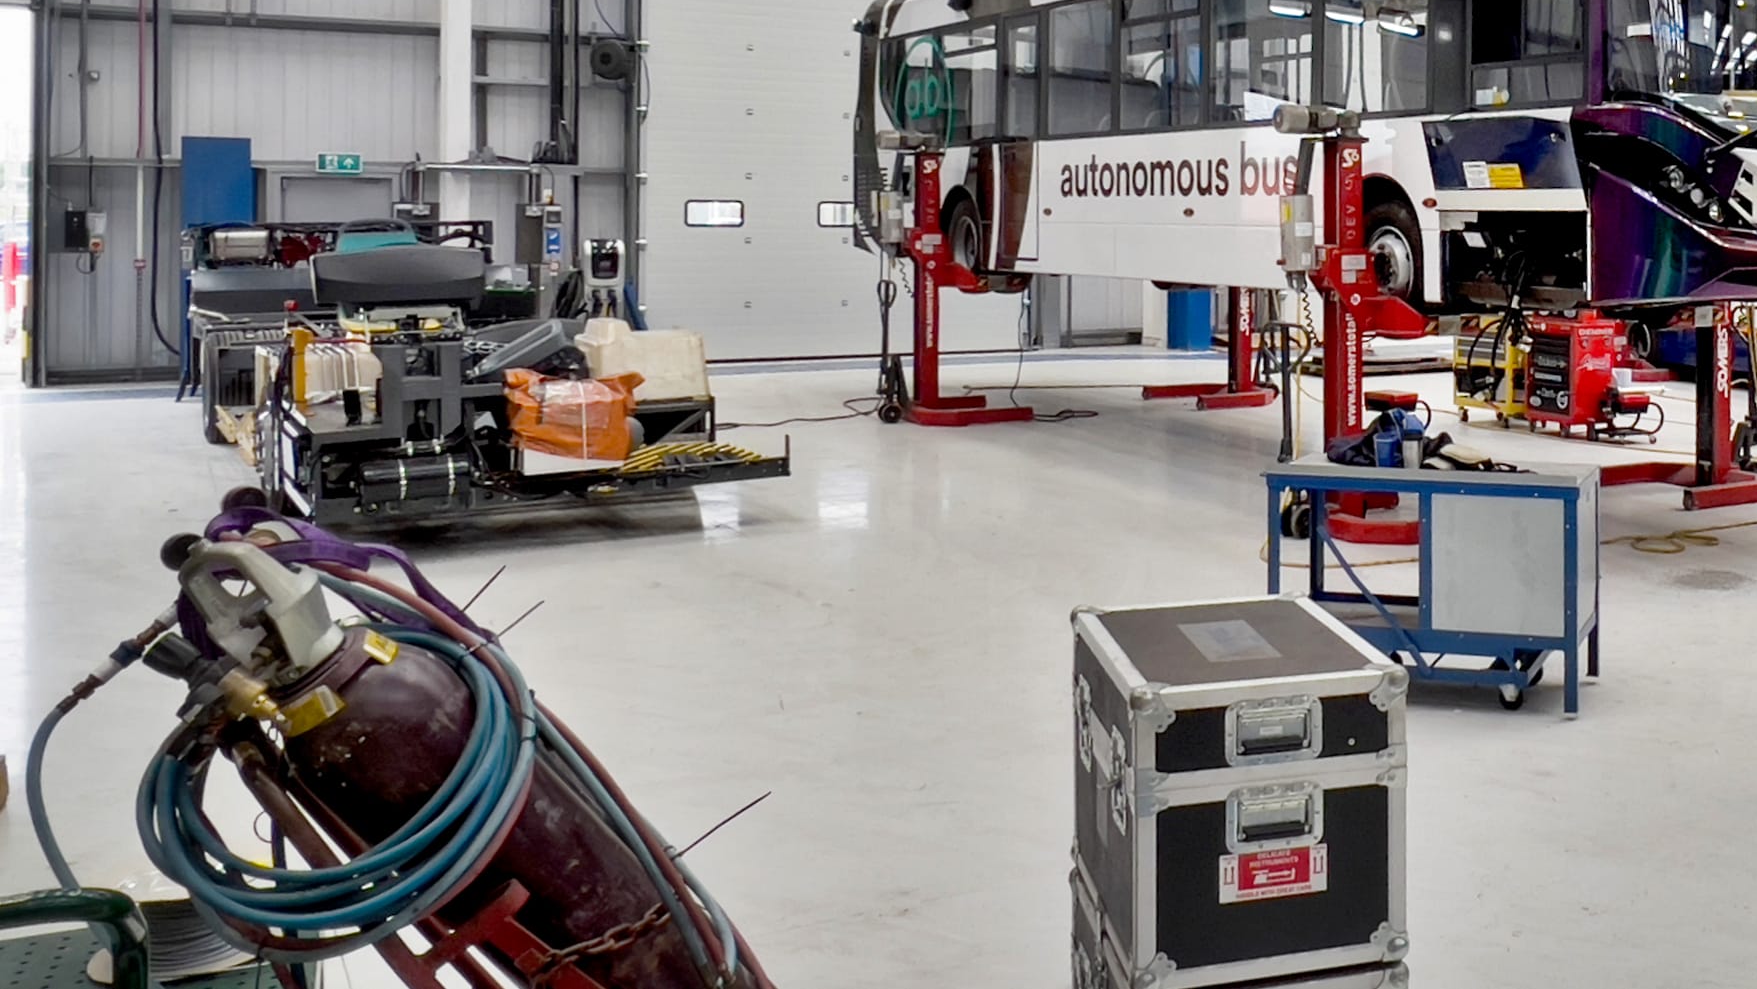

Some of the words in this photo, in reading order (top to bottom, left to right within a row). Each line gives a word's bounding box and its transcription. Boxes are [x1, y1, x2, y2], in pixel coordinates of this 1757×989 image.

[1060, 154, 1230, 198] autonomous
[1239, 140, 1298, 196] bus
[1716, 323, 1729, 398] SOMERS
